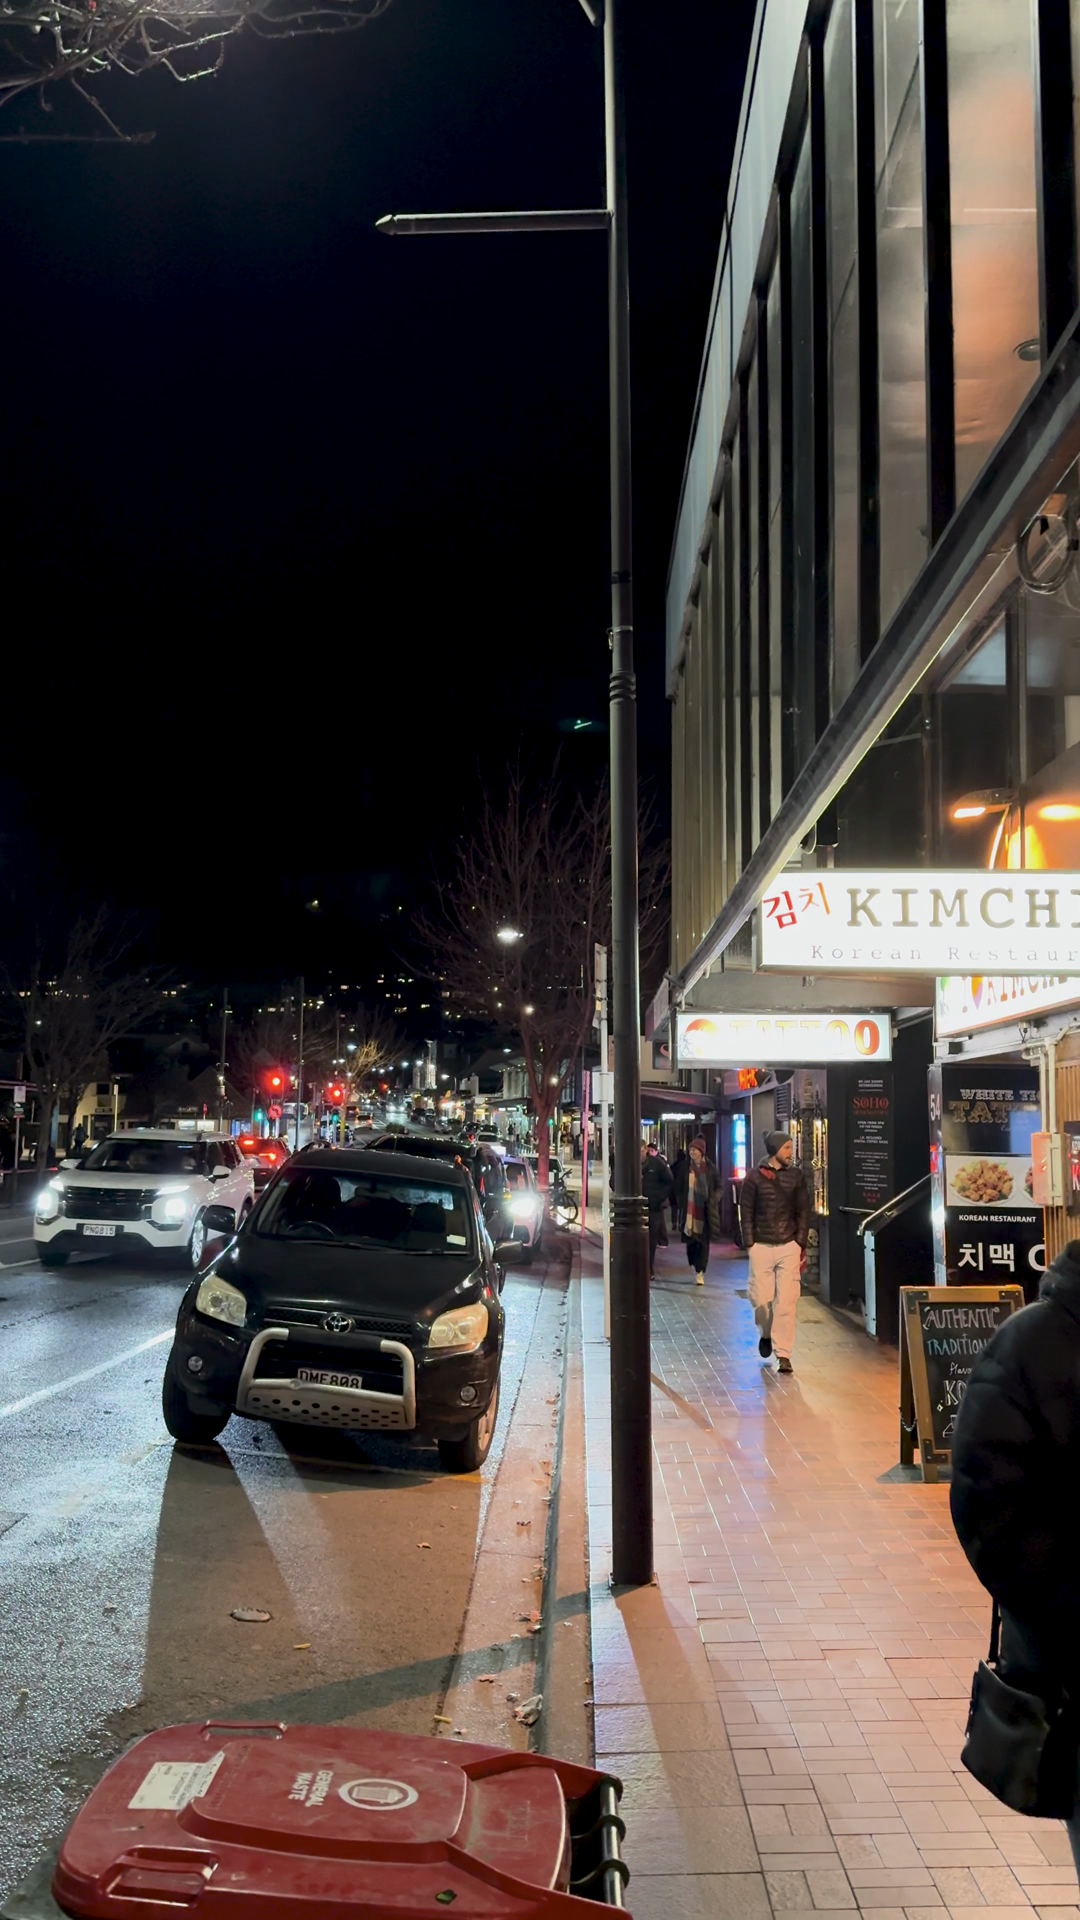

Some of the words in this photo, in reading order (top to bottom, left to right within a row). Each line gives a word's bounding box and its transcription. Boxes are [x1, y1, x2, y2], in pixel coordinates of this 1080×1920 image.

[763, 882, 831, 929] 김치
[812, 945, 921, 960] Korean
[729, 1019, 880, 1056] TATTOO
[853, 1097, 889, 1109] SOHO
[930, 1093, 941, 1121] 54
[960, 1089, 1014, 1100] WHITE
[990, 1215, 1036, 1223] RESTAURANT
[957, 1242, 1015, 1272] 치맥
[925, 1307, 999, 1329] AUTHENTIC
[288, 1772, 314, 1801] WASTE
[305, 1769, 334, 1807] GENERAL
